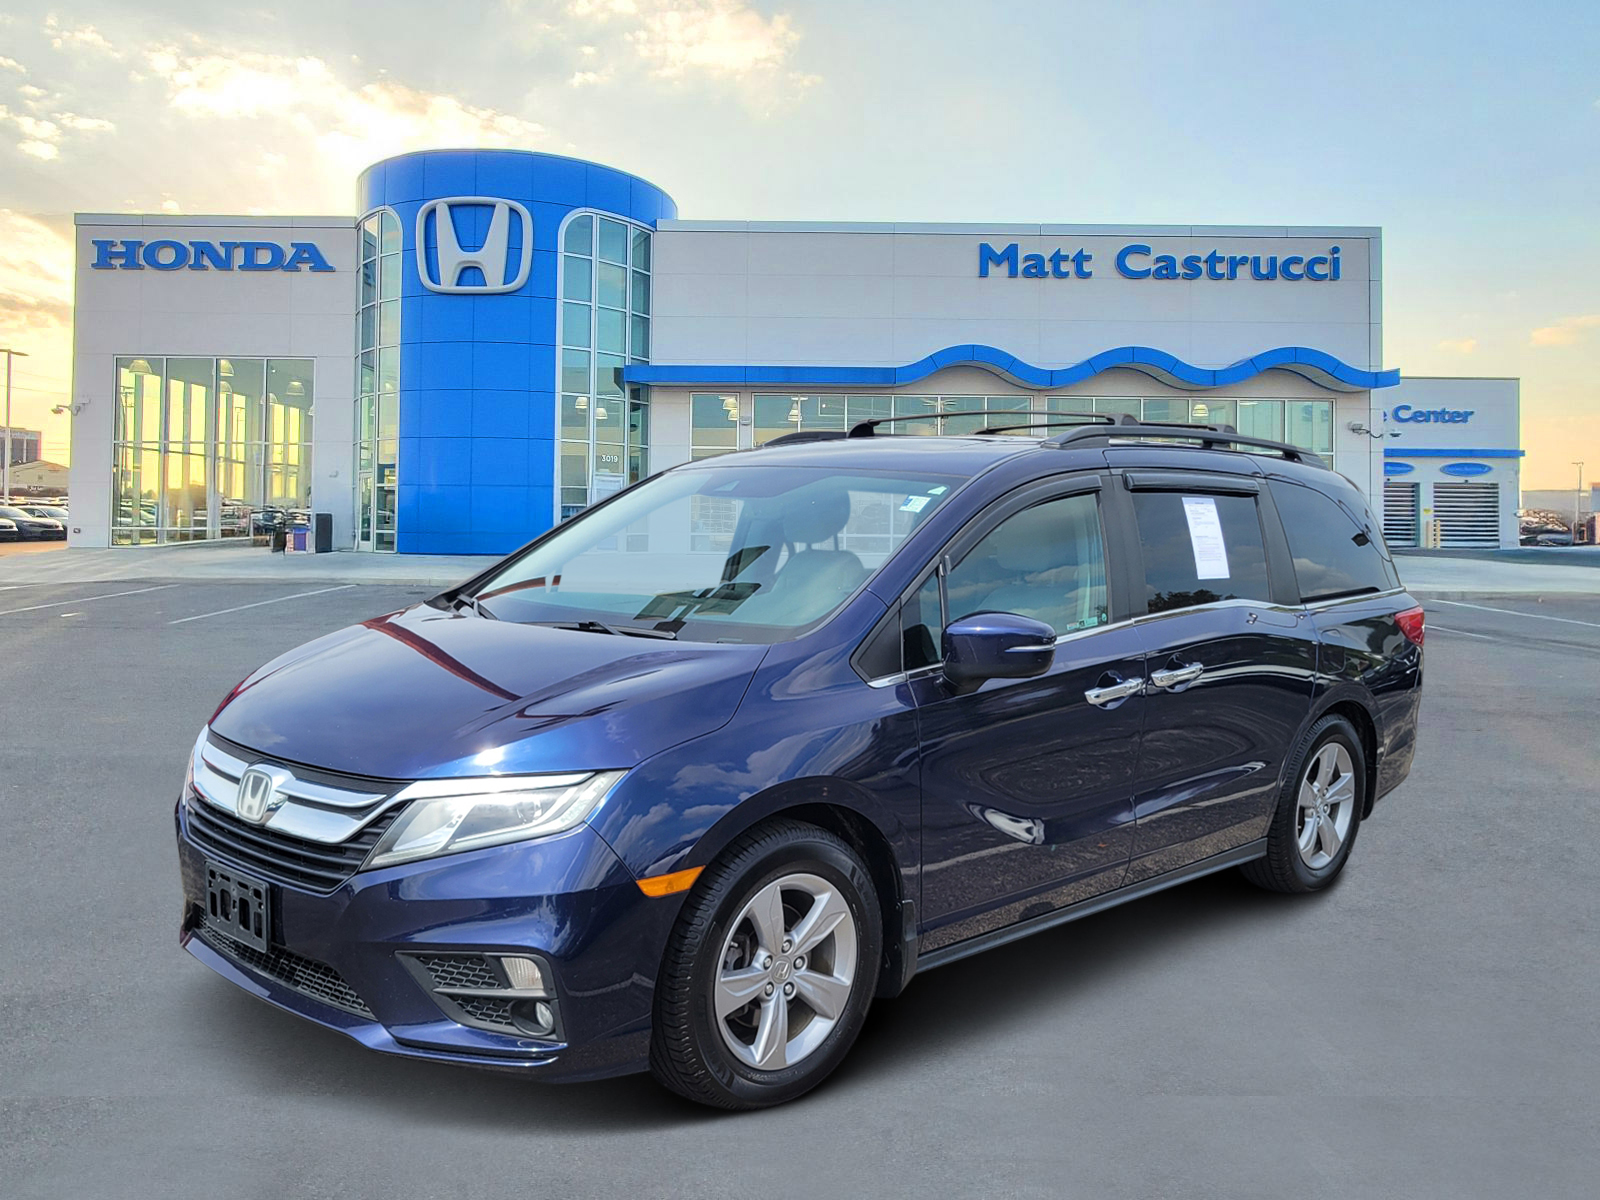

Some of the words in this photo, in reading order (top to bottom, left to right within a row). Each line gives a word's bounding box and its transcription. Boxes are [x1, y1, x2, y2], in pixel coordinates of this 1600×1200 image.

[91, 239, 336, 272] HONDA
[978, 242, 1094, 279] Matt
[1115, 243, 1342, 281] Castrucci
[1392, 404, 1475, 424] Center
[601, 454, 618, 463] 3019
